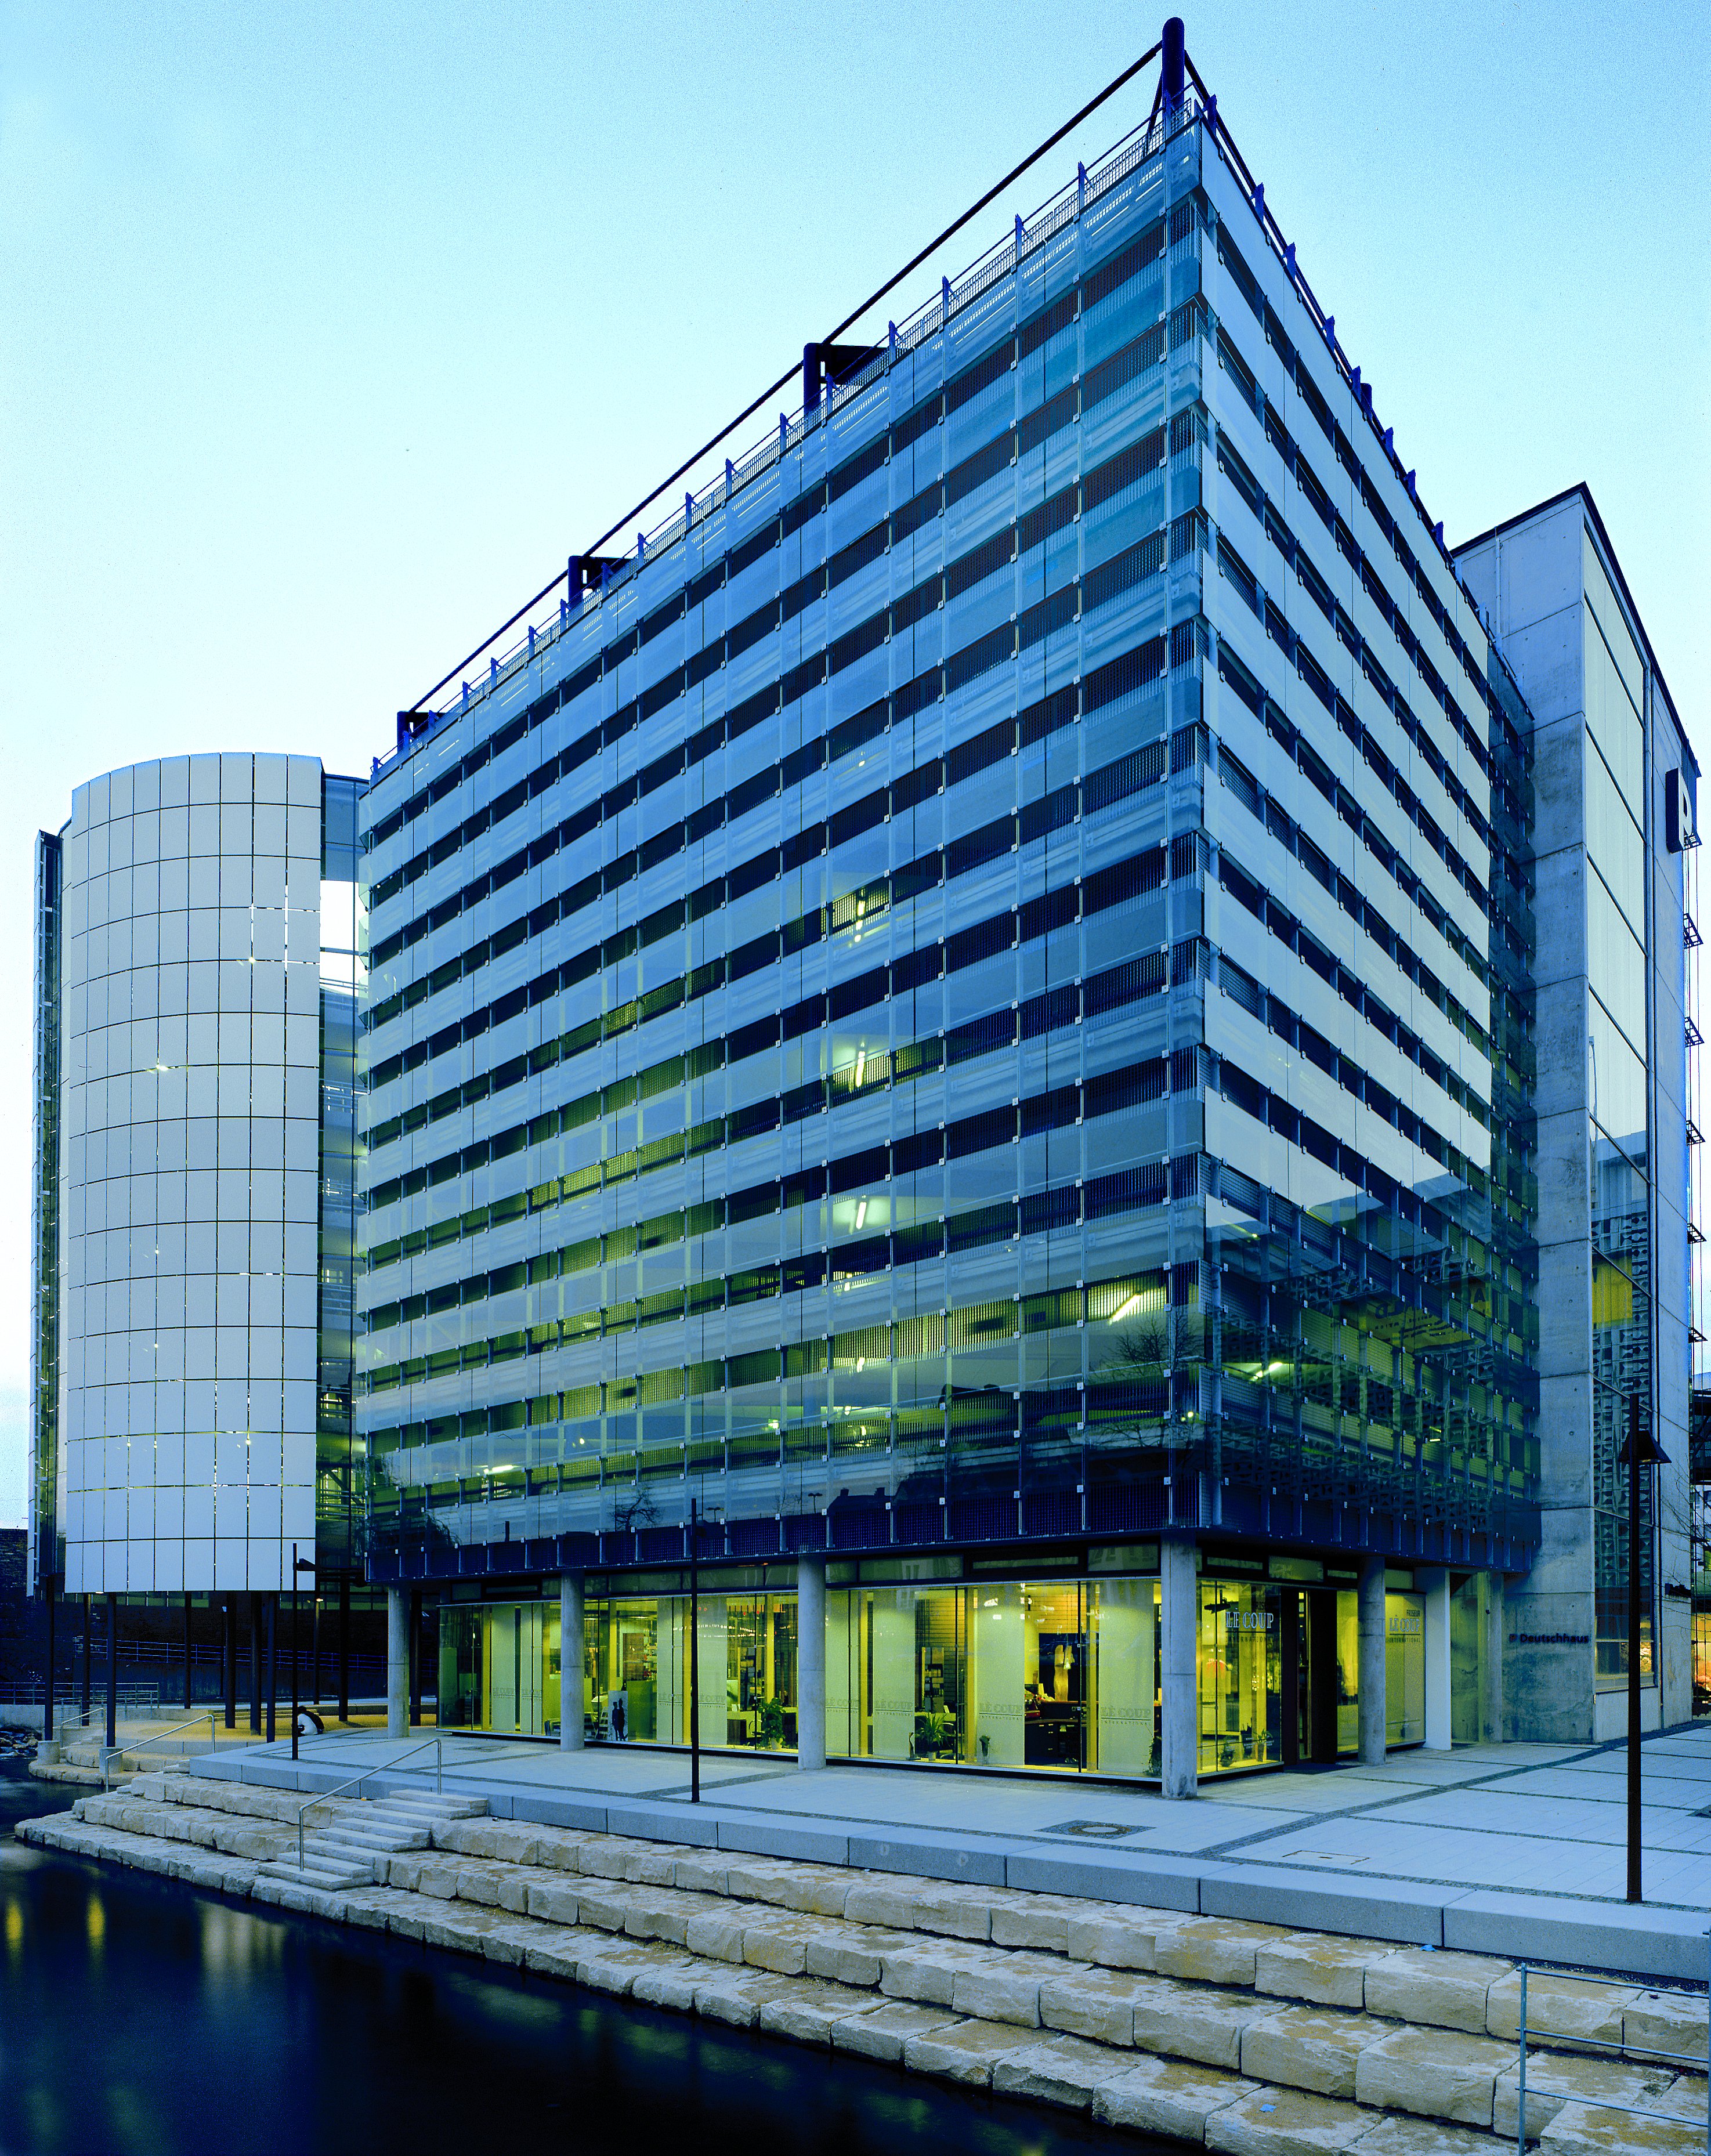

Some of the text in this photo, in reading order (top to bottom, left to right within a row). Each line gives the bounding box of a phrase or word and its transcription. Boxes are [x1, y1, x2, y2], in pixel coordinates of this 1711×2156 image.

[1242, 1612, 1274, 1629] COUP
[1400, 1618, 1421, 1632] COUP
[1520, 1633, 1589, 1644] Deutschhaus
[888, 1701, 913, 1710] COUP
[993, 1703, 1023, 1714] COUP
[1117, 1708, 1151, 1719] COUP
